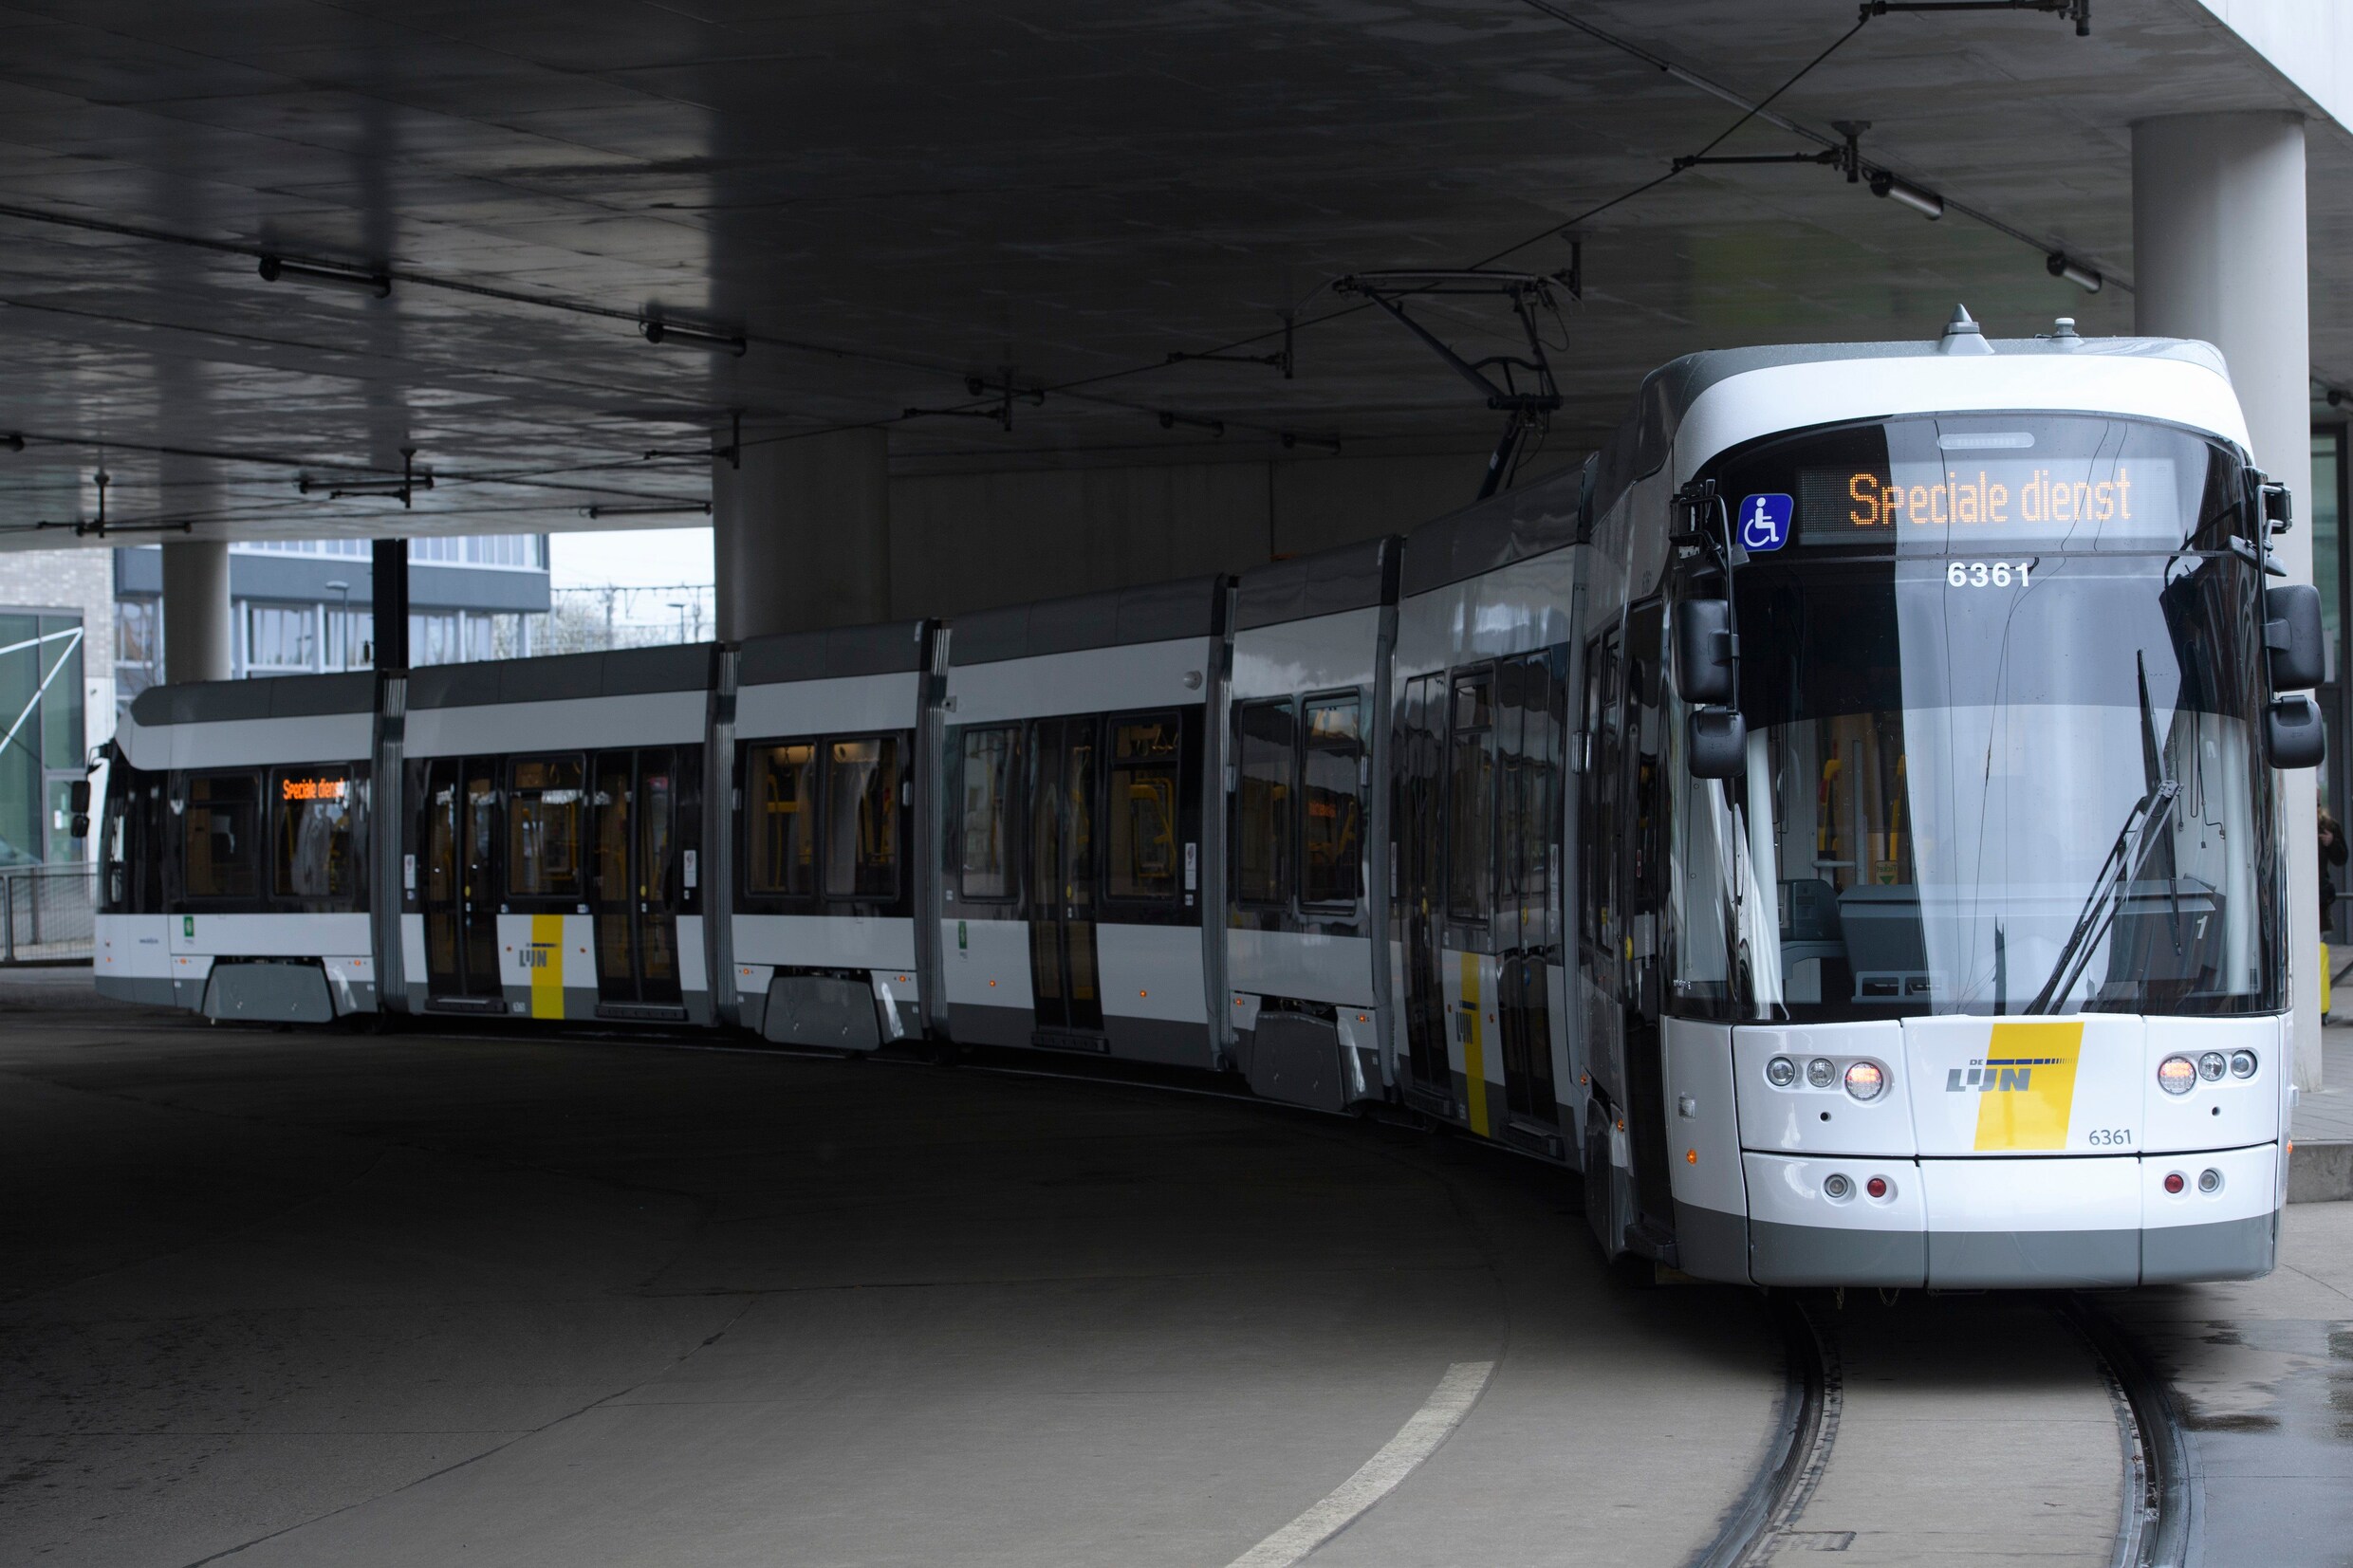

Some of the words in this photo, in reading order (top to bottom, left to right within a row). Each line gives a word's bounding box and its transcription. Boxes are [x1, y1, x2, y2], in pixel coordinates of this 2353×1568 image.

[1849, 470, 2009, 526] Speciale
[2021, 467, 2132, 522] dienst
[1947, 562, 2031, 588] 6361
[283, 778, 317, 800] Speciale
[1945, 1068, 2032, 1092] LIJN
[2088, 1128, 2132, 1146] 6361
